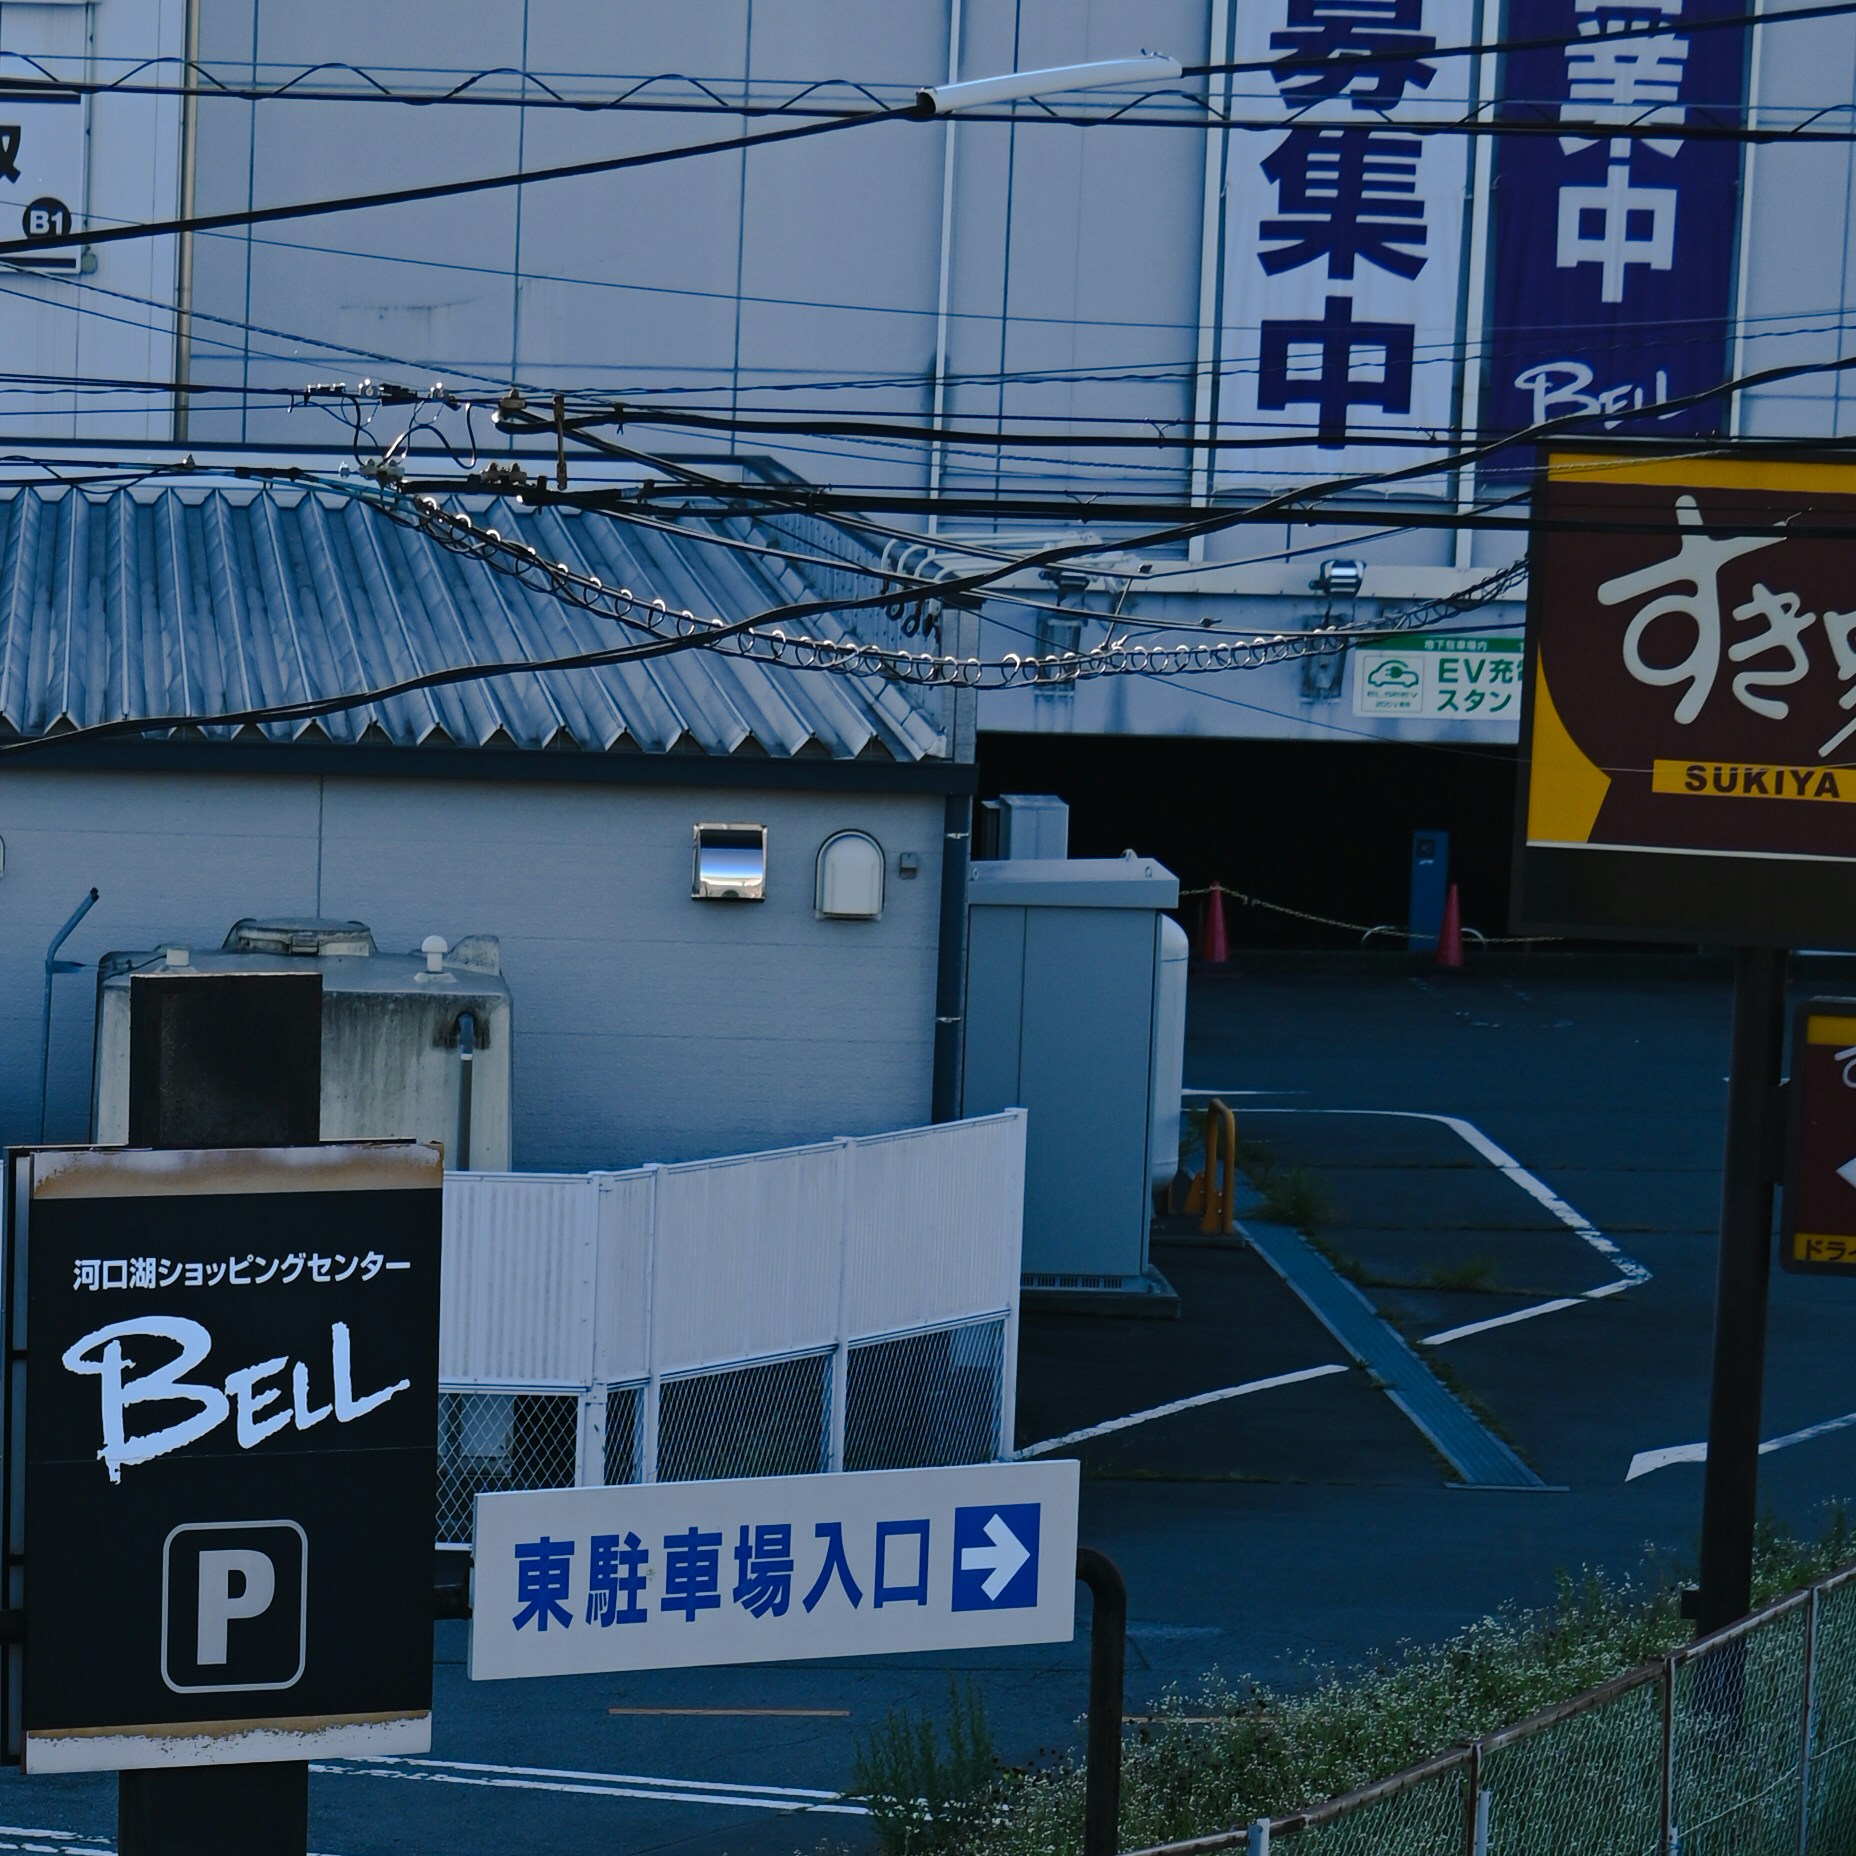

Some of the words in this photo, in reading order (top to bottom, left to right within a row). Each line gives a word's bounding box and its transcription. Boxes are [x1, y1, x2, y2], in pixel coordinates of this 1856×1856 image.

[1556, 0, 1691, 303] 業中
[30, 211, 62, 235] B1
[1438, 657, 1524, 685] EV充
[1684, 764, 1840, 799] SUKIYA
[72, 1250, 412, 1292] 河口湖ショッピングセンター
[1805, 1238, 1856, 1262] ドラ
[61, 1314, 412, 1486] BELL
[511, 1518, 931, 1633] 東駐車場入口
[196, 1549, 276, 1666] P
